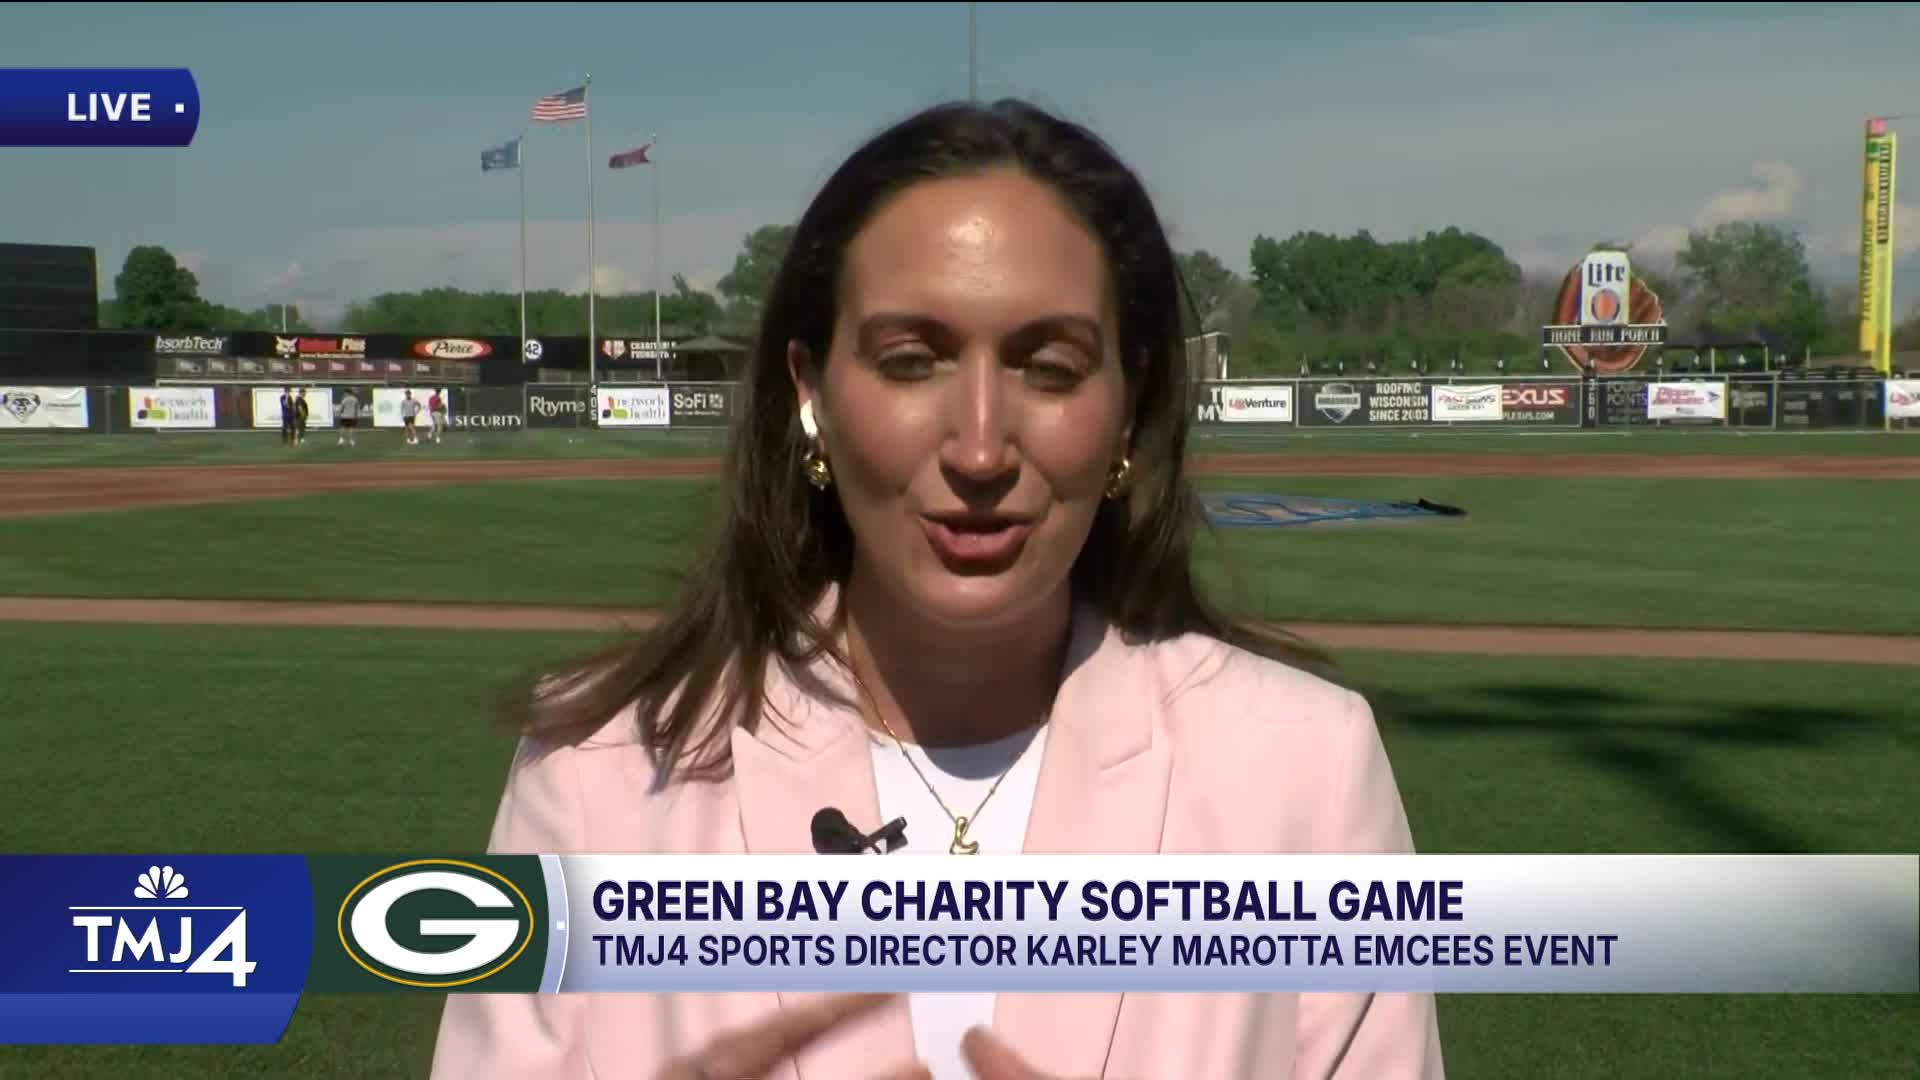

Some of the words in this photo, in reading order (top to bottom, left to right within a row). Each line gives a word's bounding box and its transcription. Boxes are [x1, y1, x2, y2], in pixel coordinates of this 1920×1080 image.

[1588, 262, 1626, 288] Lite
[1551, 329, 1582, 343] HOME
[1590, 329, 1614, 342] RUN
[1620, 328, 1660, 342] PORCH
[432, 339, 474, 357] Pierce
[526, 343, 539, 356] 42
[530, 396, 586, 417] Rhyme
[673, 392, 706, 409] SoFi
[1369, 395, 1429, 407] WISCONSIN
[1369, 409, 1400, 421] SINCE
[1402, 409, 1429, 421] 2003
